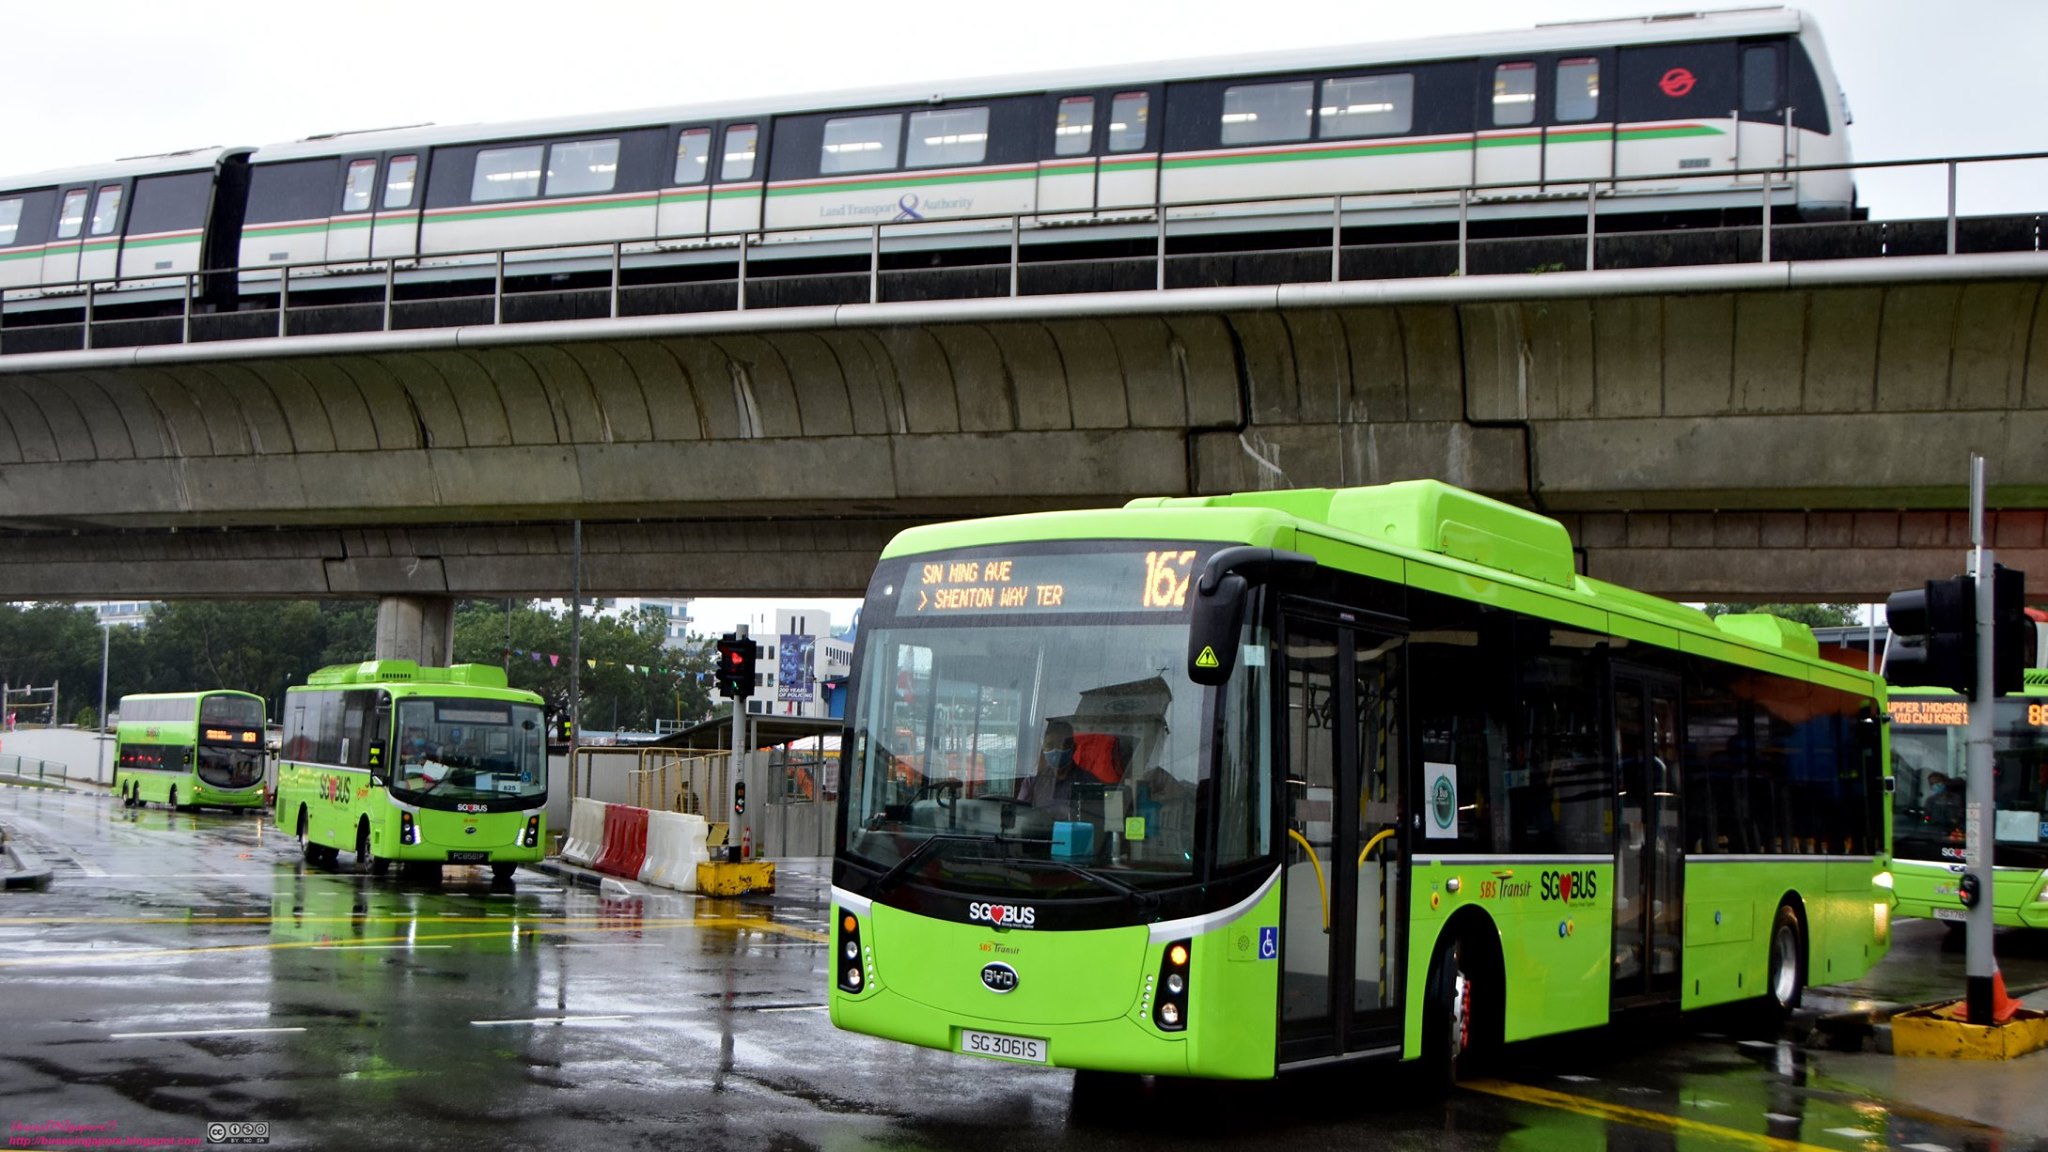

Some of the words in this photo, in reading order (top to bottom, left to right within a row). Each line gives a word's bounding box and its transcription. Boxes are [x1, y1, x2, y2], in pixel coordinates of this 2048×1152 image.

[820, 205, 845, 217] Land
[848, 202, 896, 216] Transport
[923, 197, 974, 210] Authority
[922, 563, 944, 584] SIN
[948, 562, 978, 582] MING
[984, 560, 1012, 582] AVE
[1144, 550, 1196, 608] 162
[934, 587, 994, 609] SHENTON
[1000, 586, 1028, 606] WAY
[1036, 584, 1064, 606] TER
[1887, 702, 1919, 713] UPPER
[1921, 702, 1968, 714] THOMSON
[1480, 882, 1496, 899] SBS
[1496, 874, 1532, 900] Transit
[979, 943, 992, 952] SBS
[993, 942, 1020, 955] Transit
